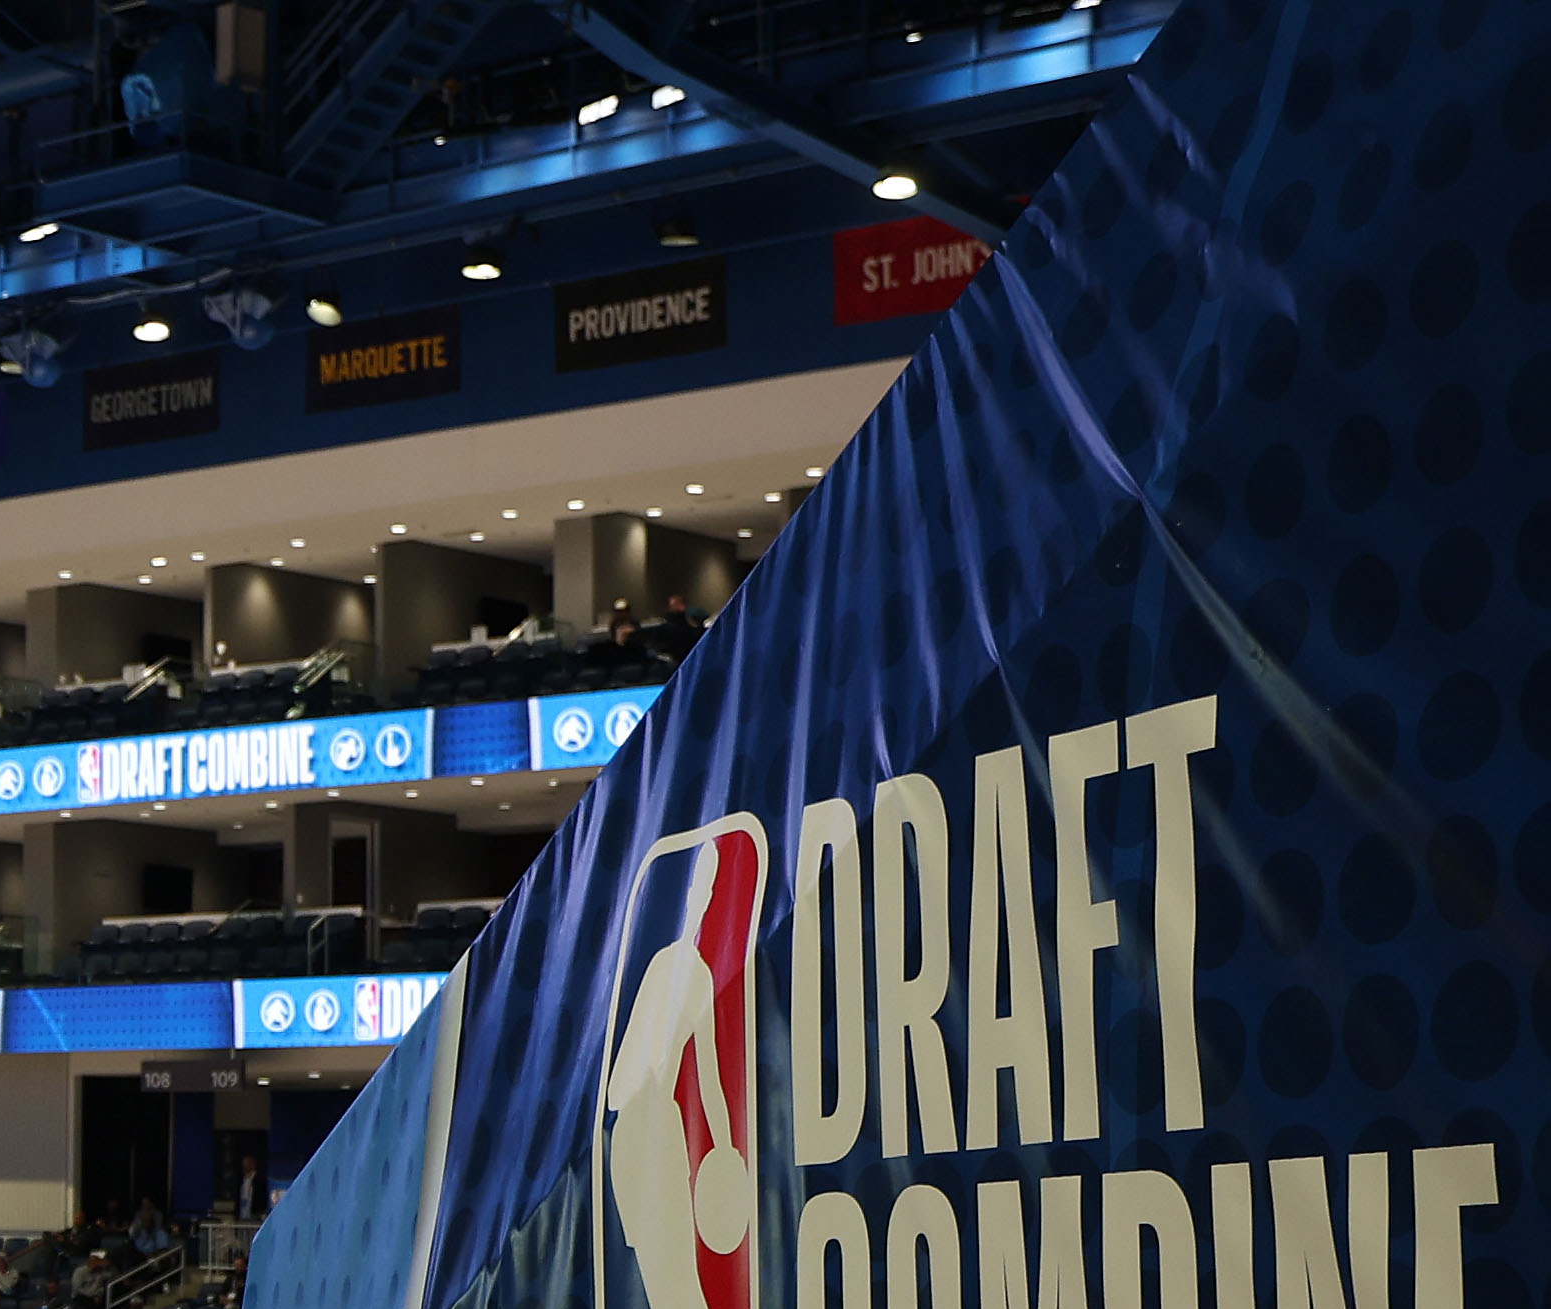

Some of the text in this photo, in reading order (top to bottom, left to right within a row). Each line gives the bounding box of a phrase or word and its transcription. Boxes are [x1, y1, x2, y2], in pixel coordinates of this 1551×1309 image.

[862, 254, 900, 293] ST.
[569, 287, 712, 343] PROVIDENCE
[320, 335, 448, 385] MARQUETTE
[91, 376, 214, 424] GEORGETOWN
[103, 725, 315, 801] DRAFT COMBINE
[792, 694, 1219, 1167] DRAFT
[143, 1070, 239, 1089] 108 109
